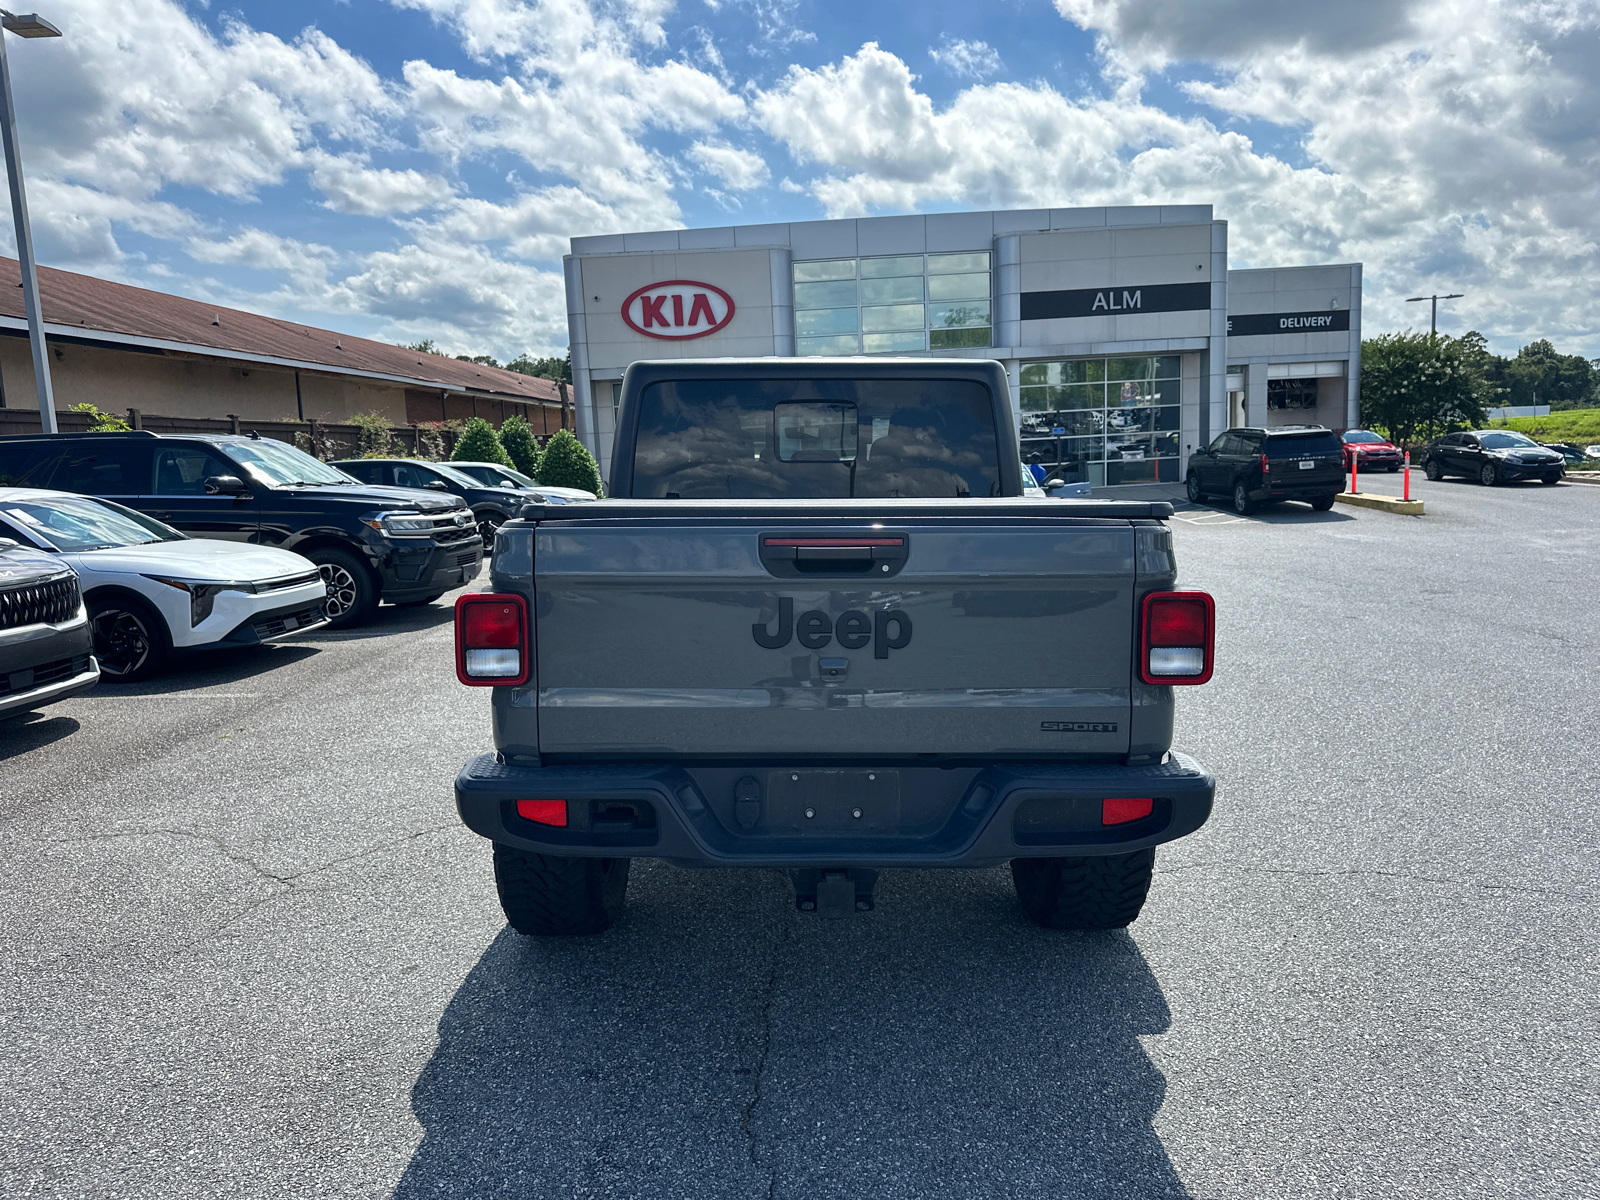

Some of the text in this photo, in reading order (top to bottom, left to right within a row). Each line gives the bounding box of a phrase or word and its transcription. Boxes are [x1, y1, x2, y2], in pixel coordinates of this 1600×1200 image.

[640, 293, 718, 328] KIA
[1091, 290, 1141, 311] ALM
[1280, 316, 1332, 329] DELIVERY
[752, 597, 913, 659] Jeep
[1041, 722, 1118, 732] SPORT
